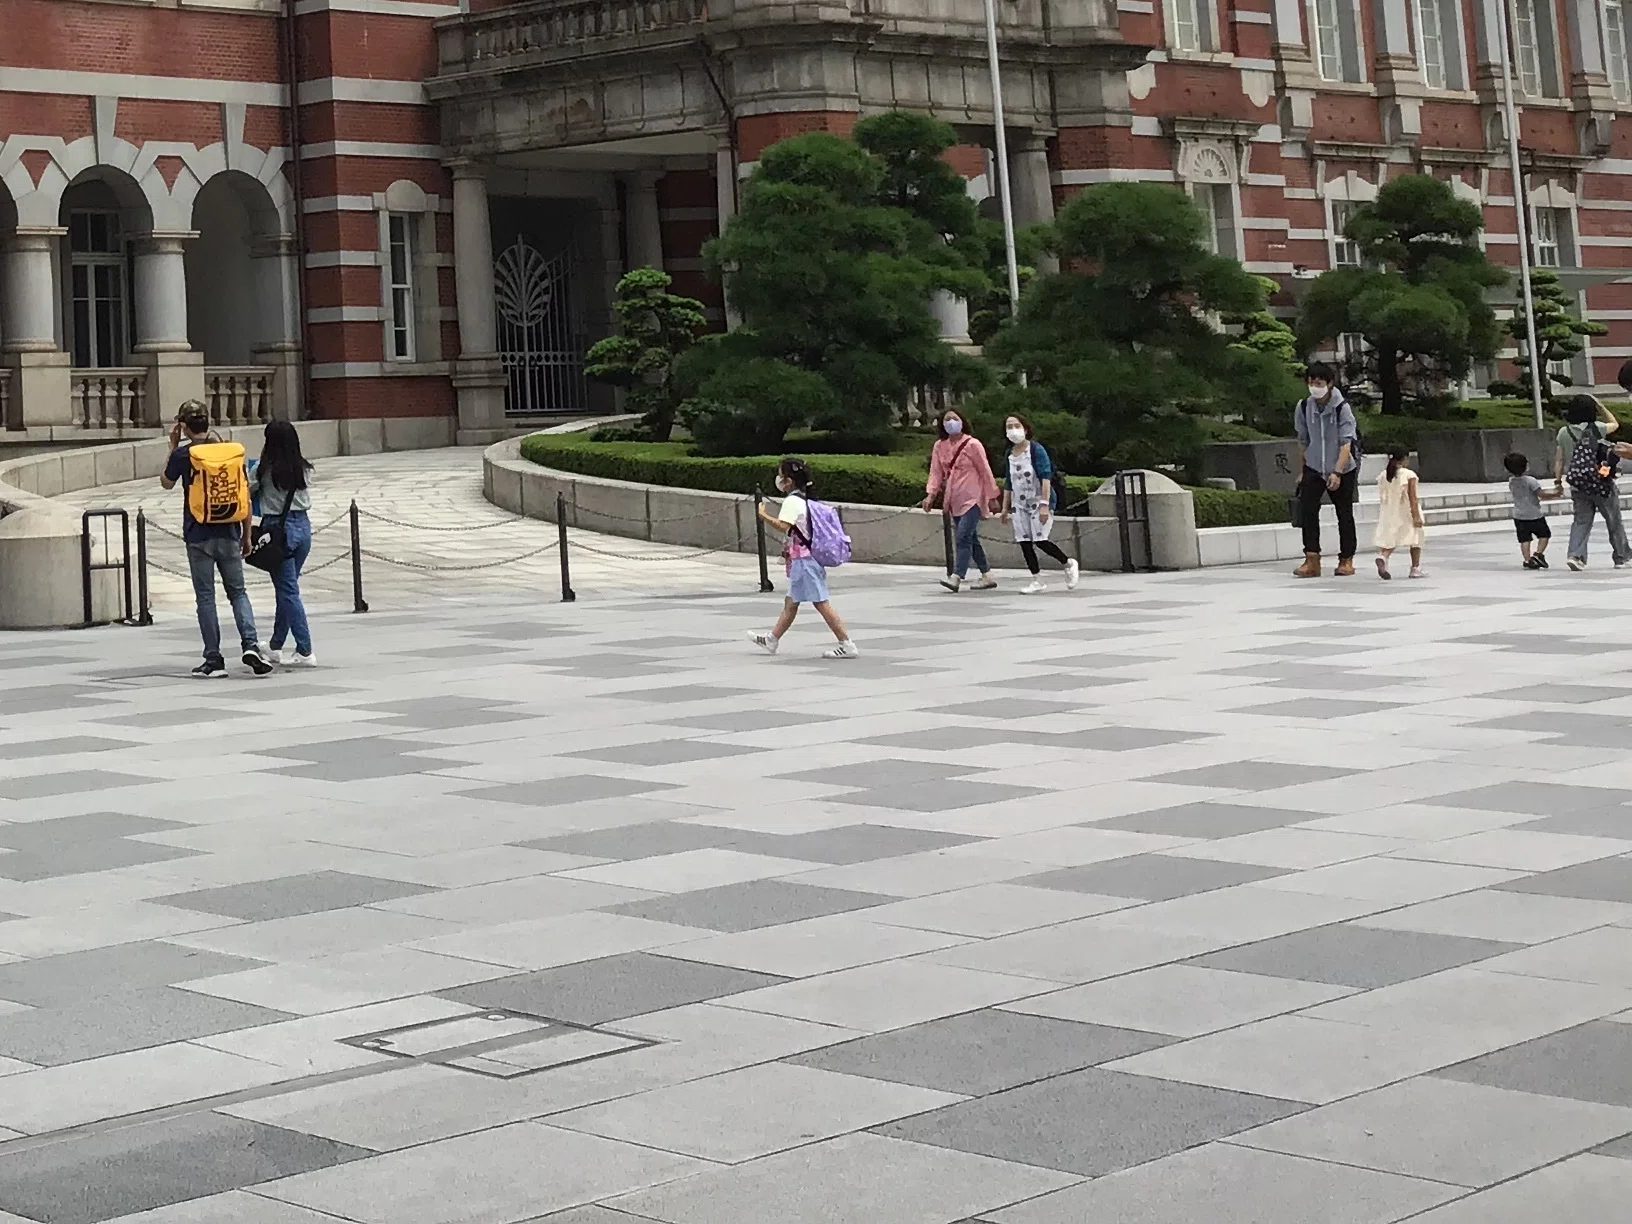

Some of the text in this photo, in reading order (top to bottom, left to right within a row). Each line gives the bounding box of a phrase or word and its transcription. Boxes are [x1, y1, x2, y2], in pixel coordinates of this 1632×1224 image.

[209, 475, 220, 504] FACE
[218, 464, 229, 504] NORTH
[228, 479, 238, 502] THE
